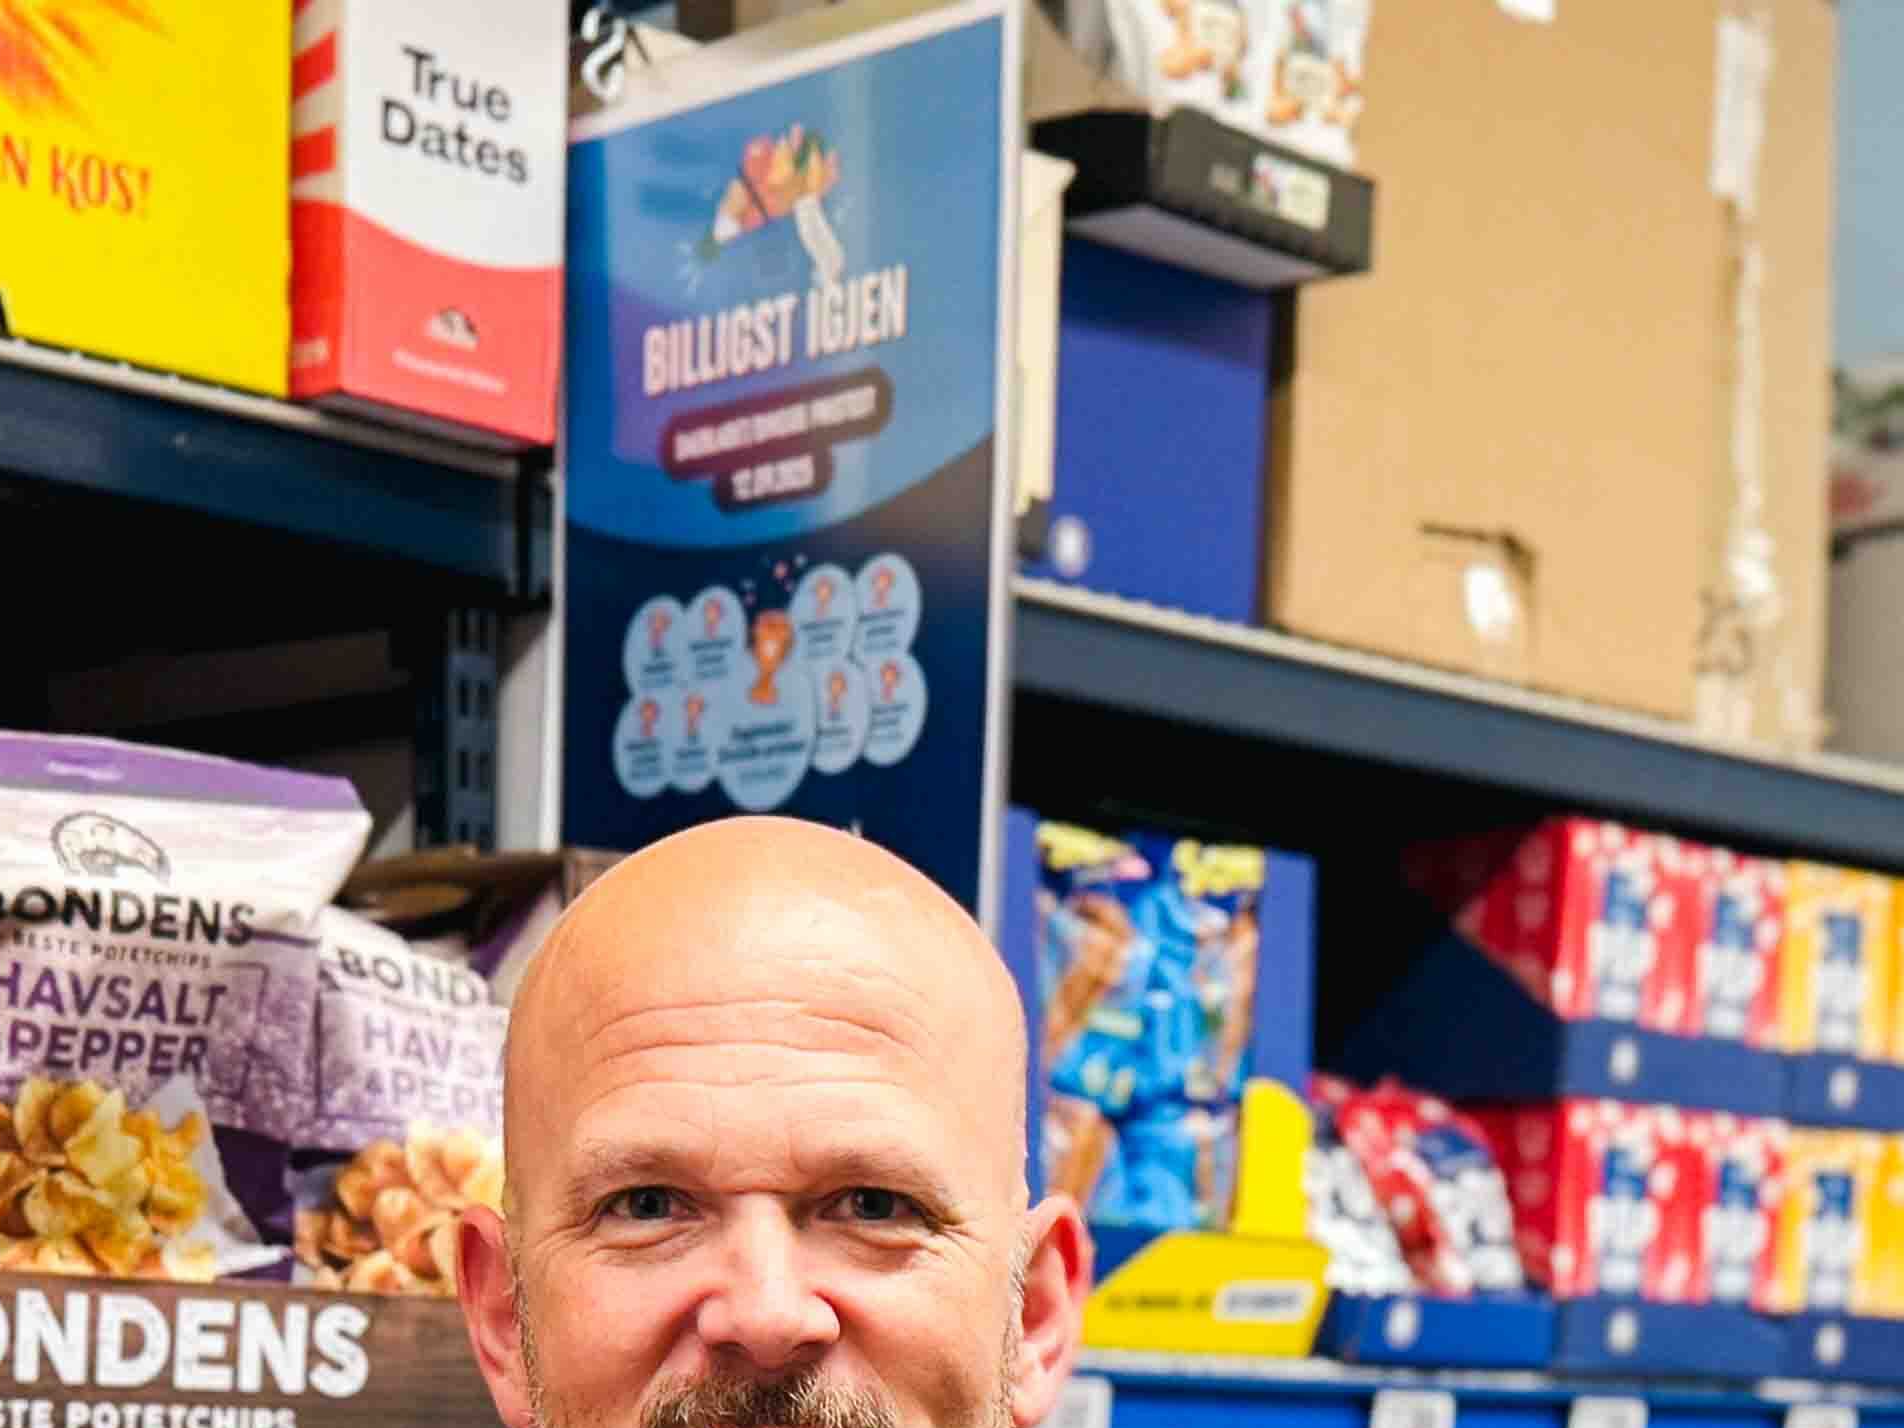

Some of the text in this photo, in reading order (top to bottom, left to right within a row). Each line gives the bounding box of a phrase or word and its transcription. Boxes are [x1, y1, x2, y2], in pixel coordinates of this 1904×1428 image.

[402, 44, 512, 123] True
[381, 97, 529, 187] Dates
[50, 145, 153, 219] KOS!
[644, 263, 908, 398] BILLIGST IGJEN
[337, 948, 480, 1008] BOND
